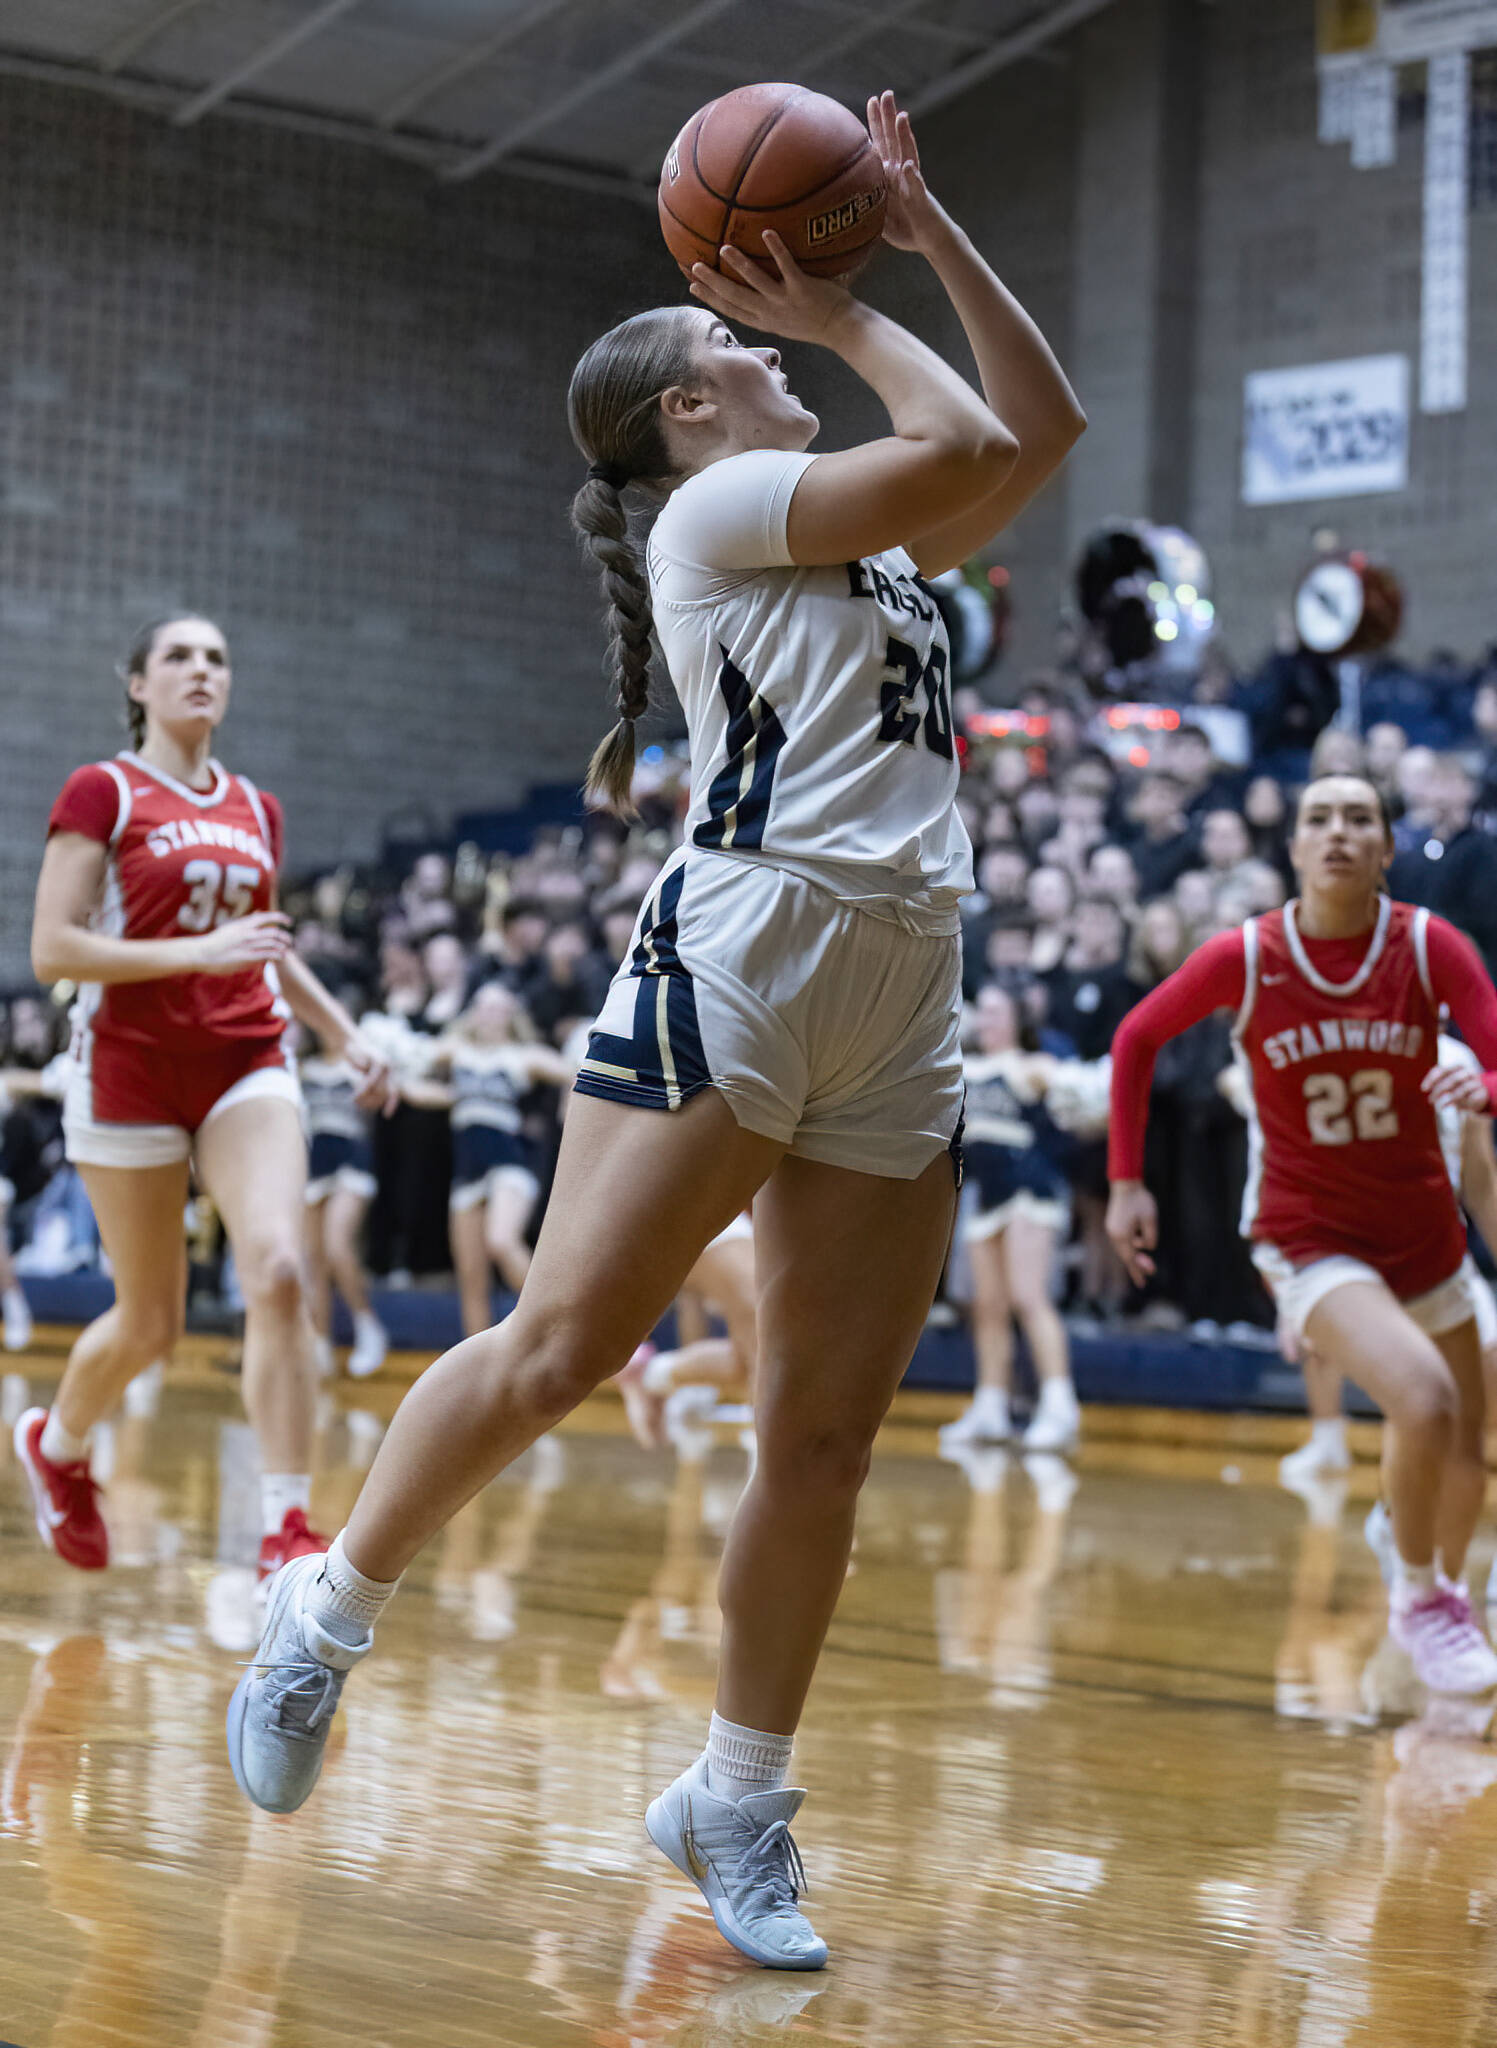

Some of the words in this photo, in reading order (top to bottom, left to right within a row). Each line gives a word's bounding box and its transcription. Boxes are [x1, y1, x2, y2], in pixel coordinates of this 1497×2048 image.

[847, 560, 940, 622] EAGL
[878, 636, 953, 761] 20
[178, 860, 259, 932] 35
[1263, 1018, 1423, 1069] STANWOOD
[1303, 1069, 1398, 1144] 22
